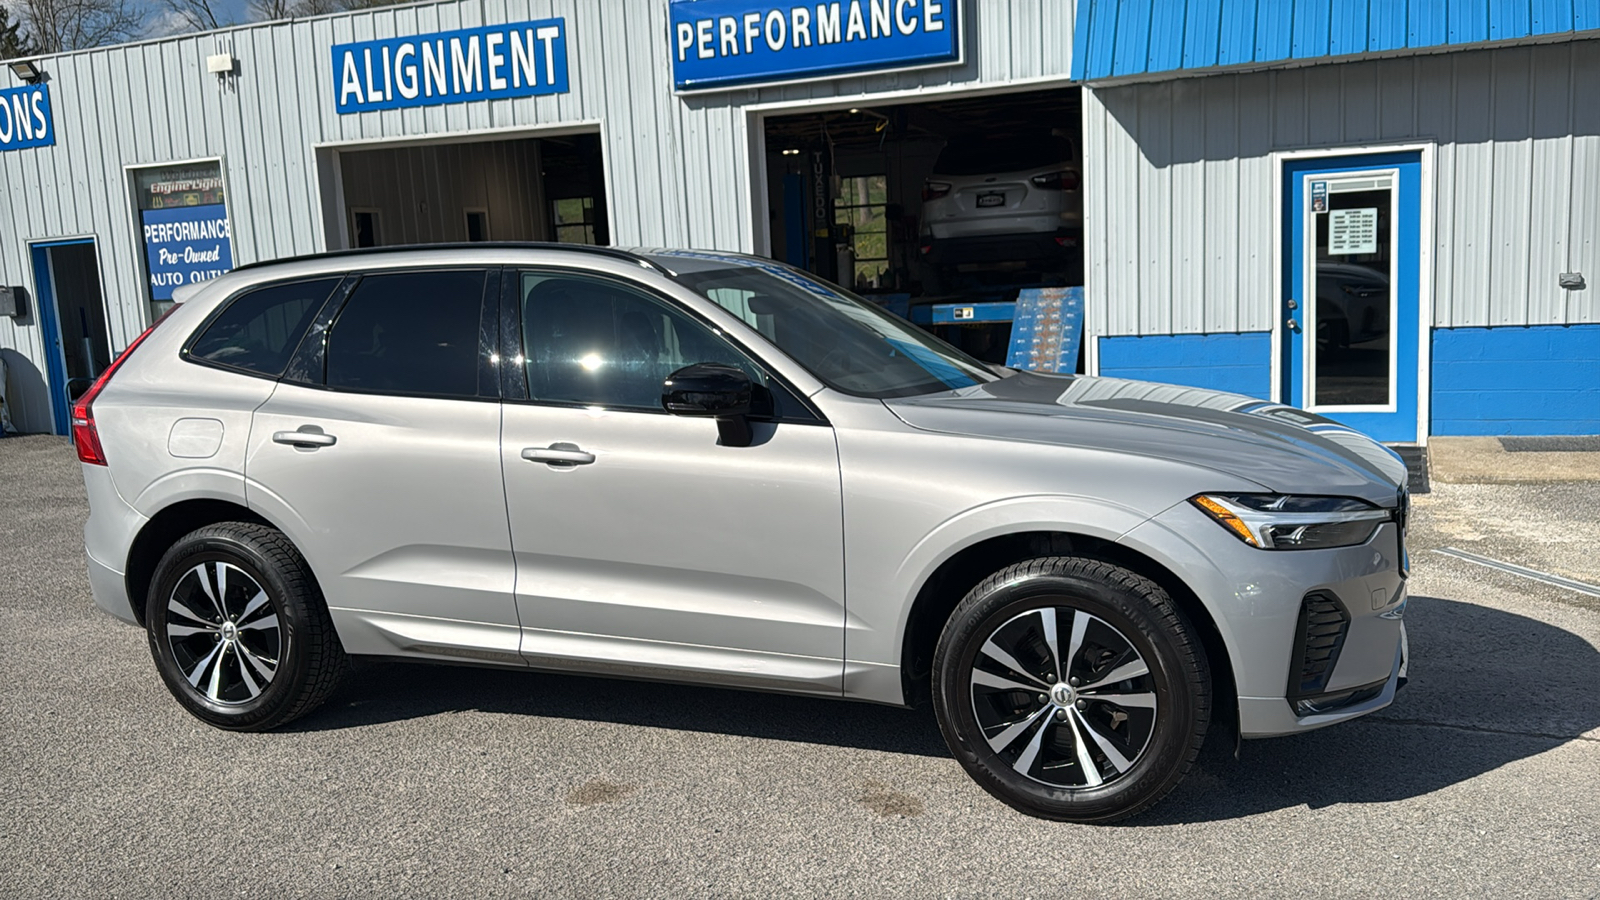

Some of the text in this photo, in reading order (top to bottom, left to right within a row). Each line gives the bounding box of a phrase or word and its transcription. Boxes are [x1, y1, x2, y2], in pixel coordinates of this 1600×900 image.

[676, 0, 944, 62] PERFORMANCE
[340, 26, 559, 106] ALIGNMENT
[0, 90, 47, 144] ONS
[150, 180, 190, 195] Engine
[144, 218, 231, 244] PERFORMANCE
[158, 244, 220, 266] Pre-Owned
[151, 271, 184, 287] AUTO
